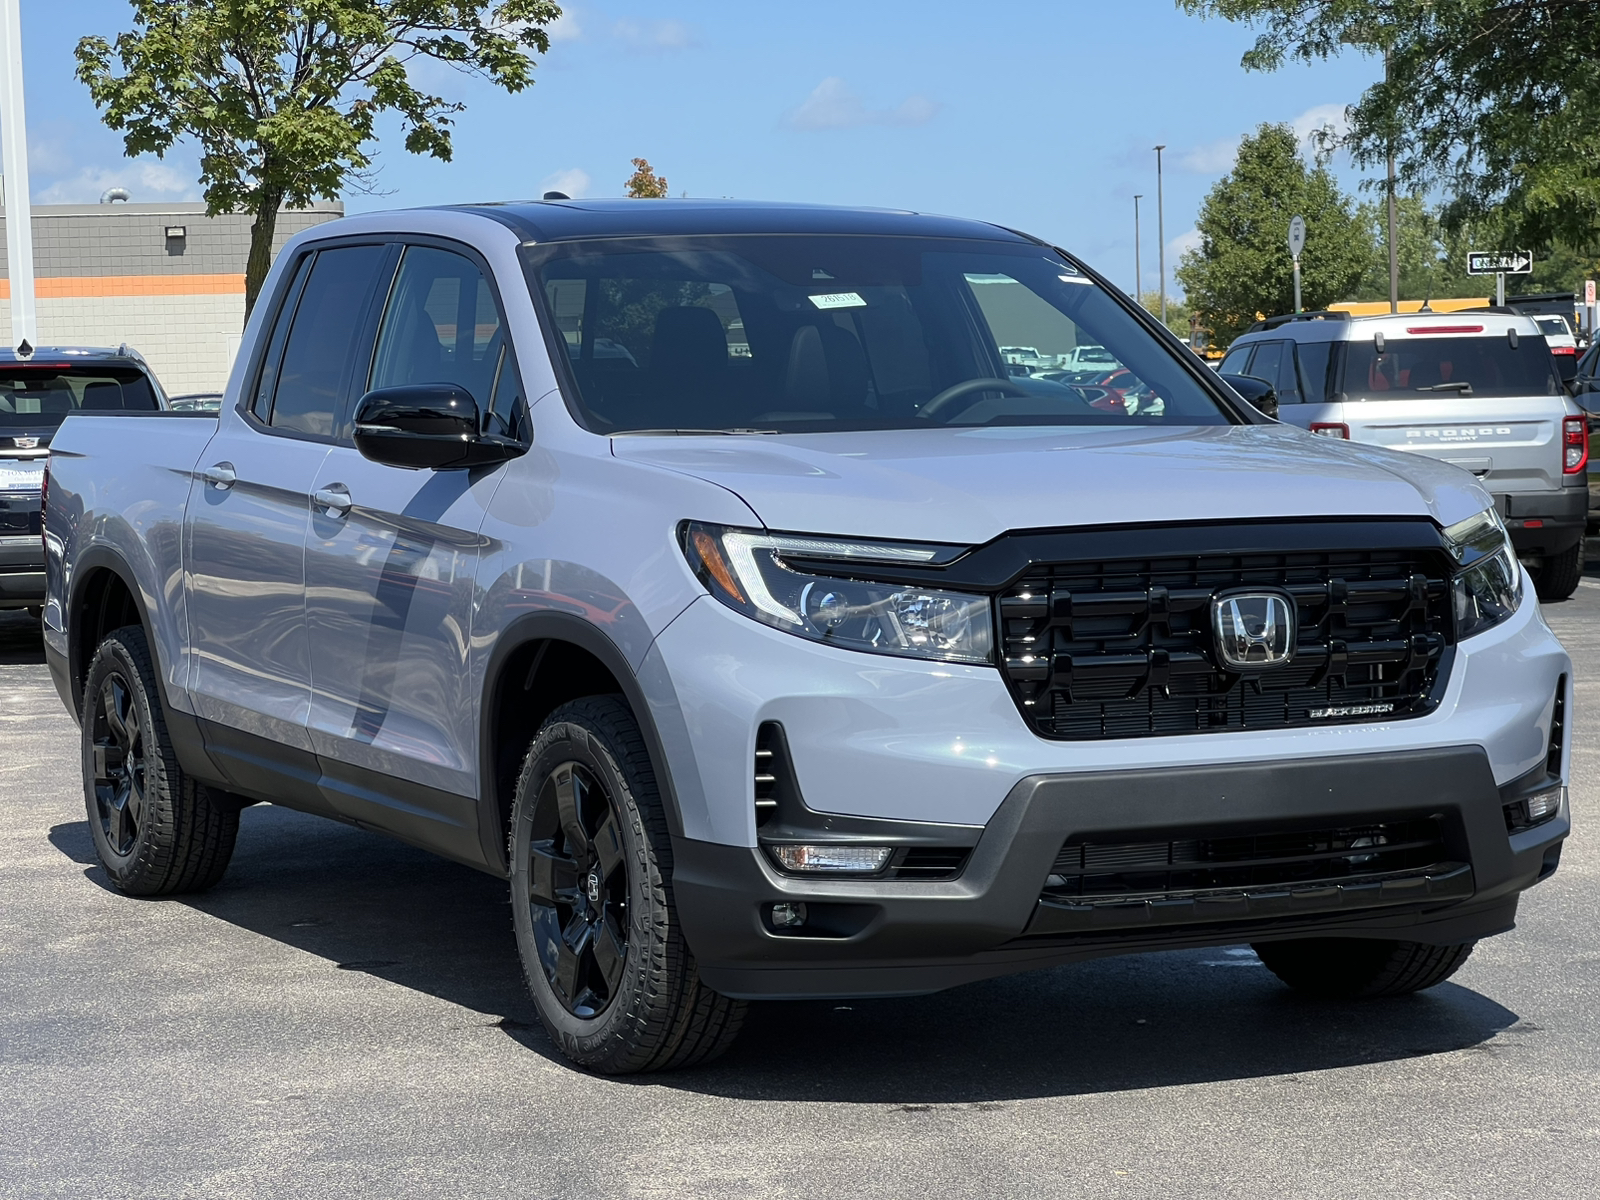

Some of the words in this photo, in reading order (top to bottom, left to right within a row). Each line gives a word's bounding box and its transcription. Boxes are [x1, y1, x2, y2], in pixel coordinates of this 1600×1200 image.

[1406, 427, 1511, 438] BRONCO
[1309, 707, 1350, 718] BLACK
[1351, 703, 1394, 715] EDITION
